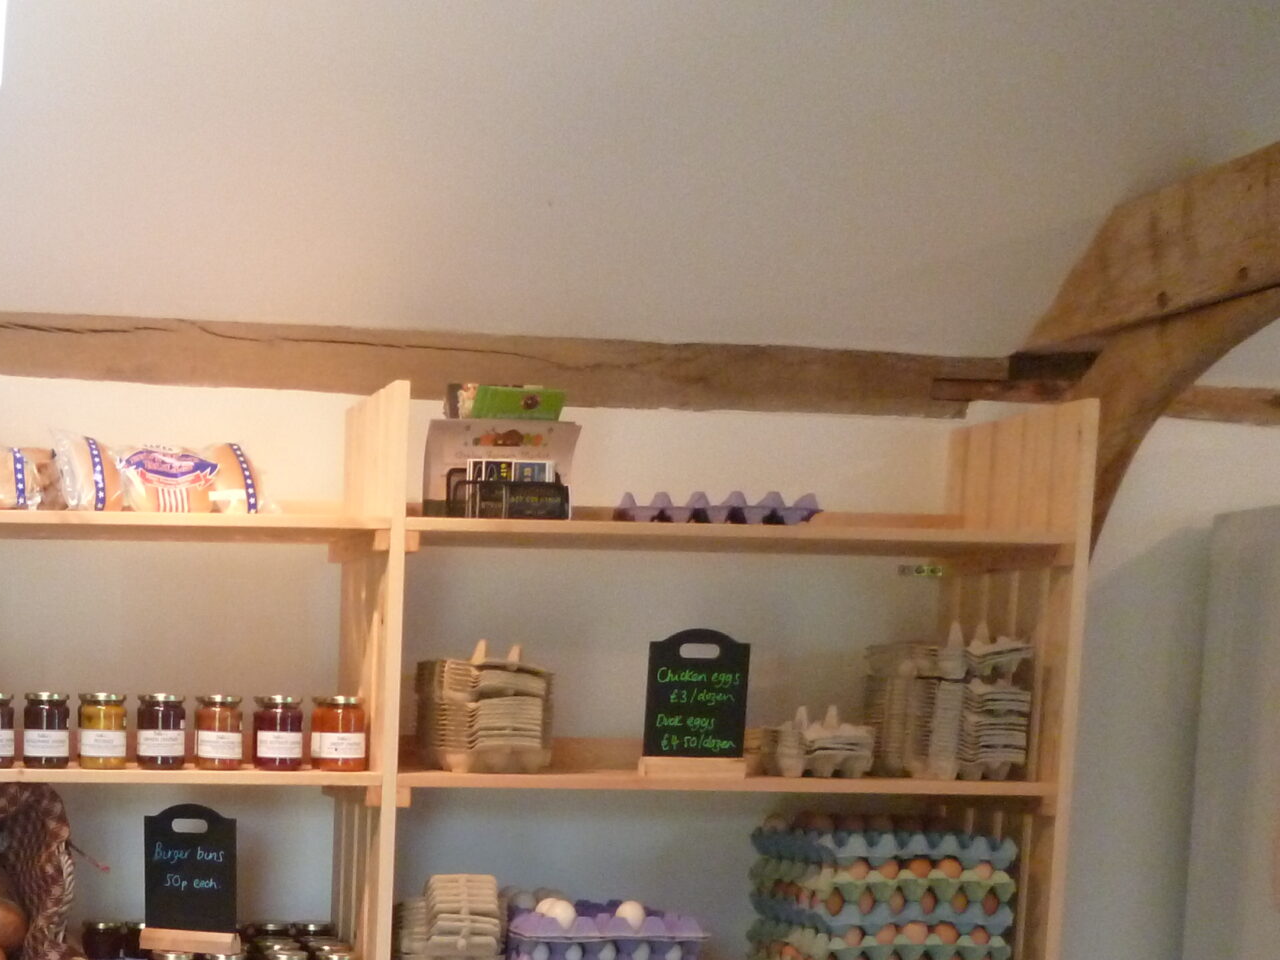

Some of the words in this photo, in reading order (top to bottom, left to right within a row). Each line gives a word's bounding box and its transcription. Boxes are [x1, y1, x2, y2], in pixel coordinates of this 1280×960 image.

[657, 667, 707, 683] Chicken
[711, 671, 741, 688] eggs
[656, 713, 683, 728] Duck
[686, 716, 715, 732] eggs
[153, 841, 191, 864] Burger
[196, 846, 225, 862] buns
[164, 873, 188, 891] 50p
